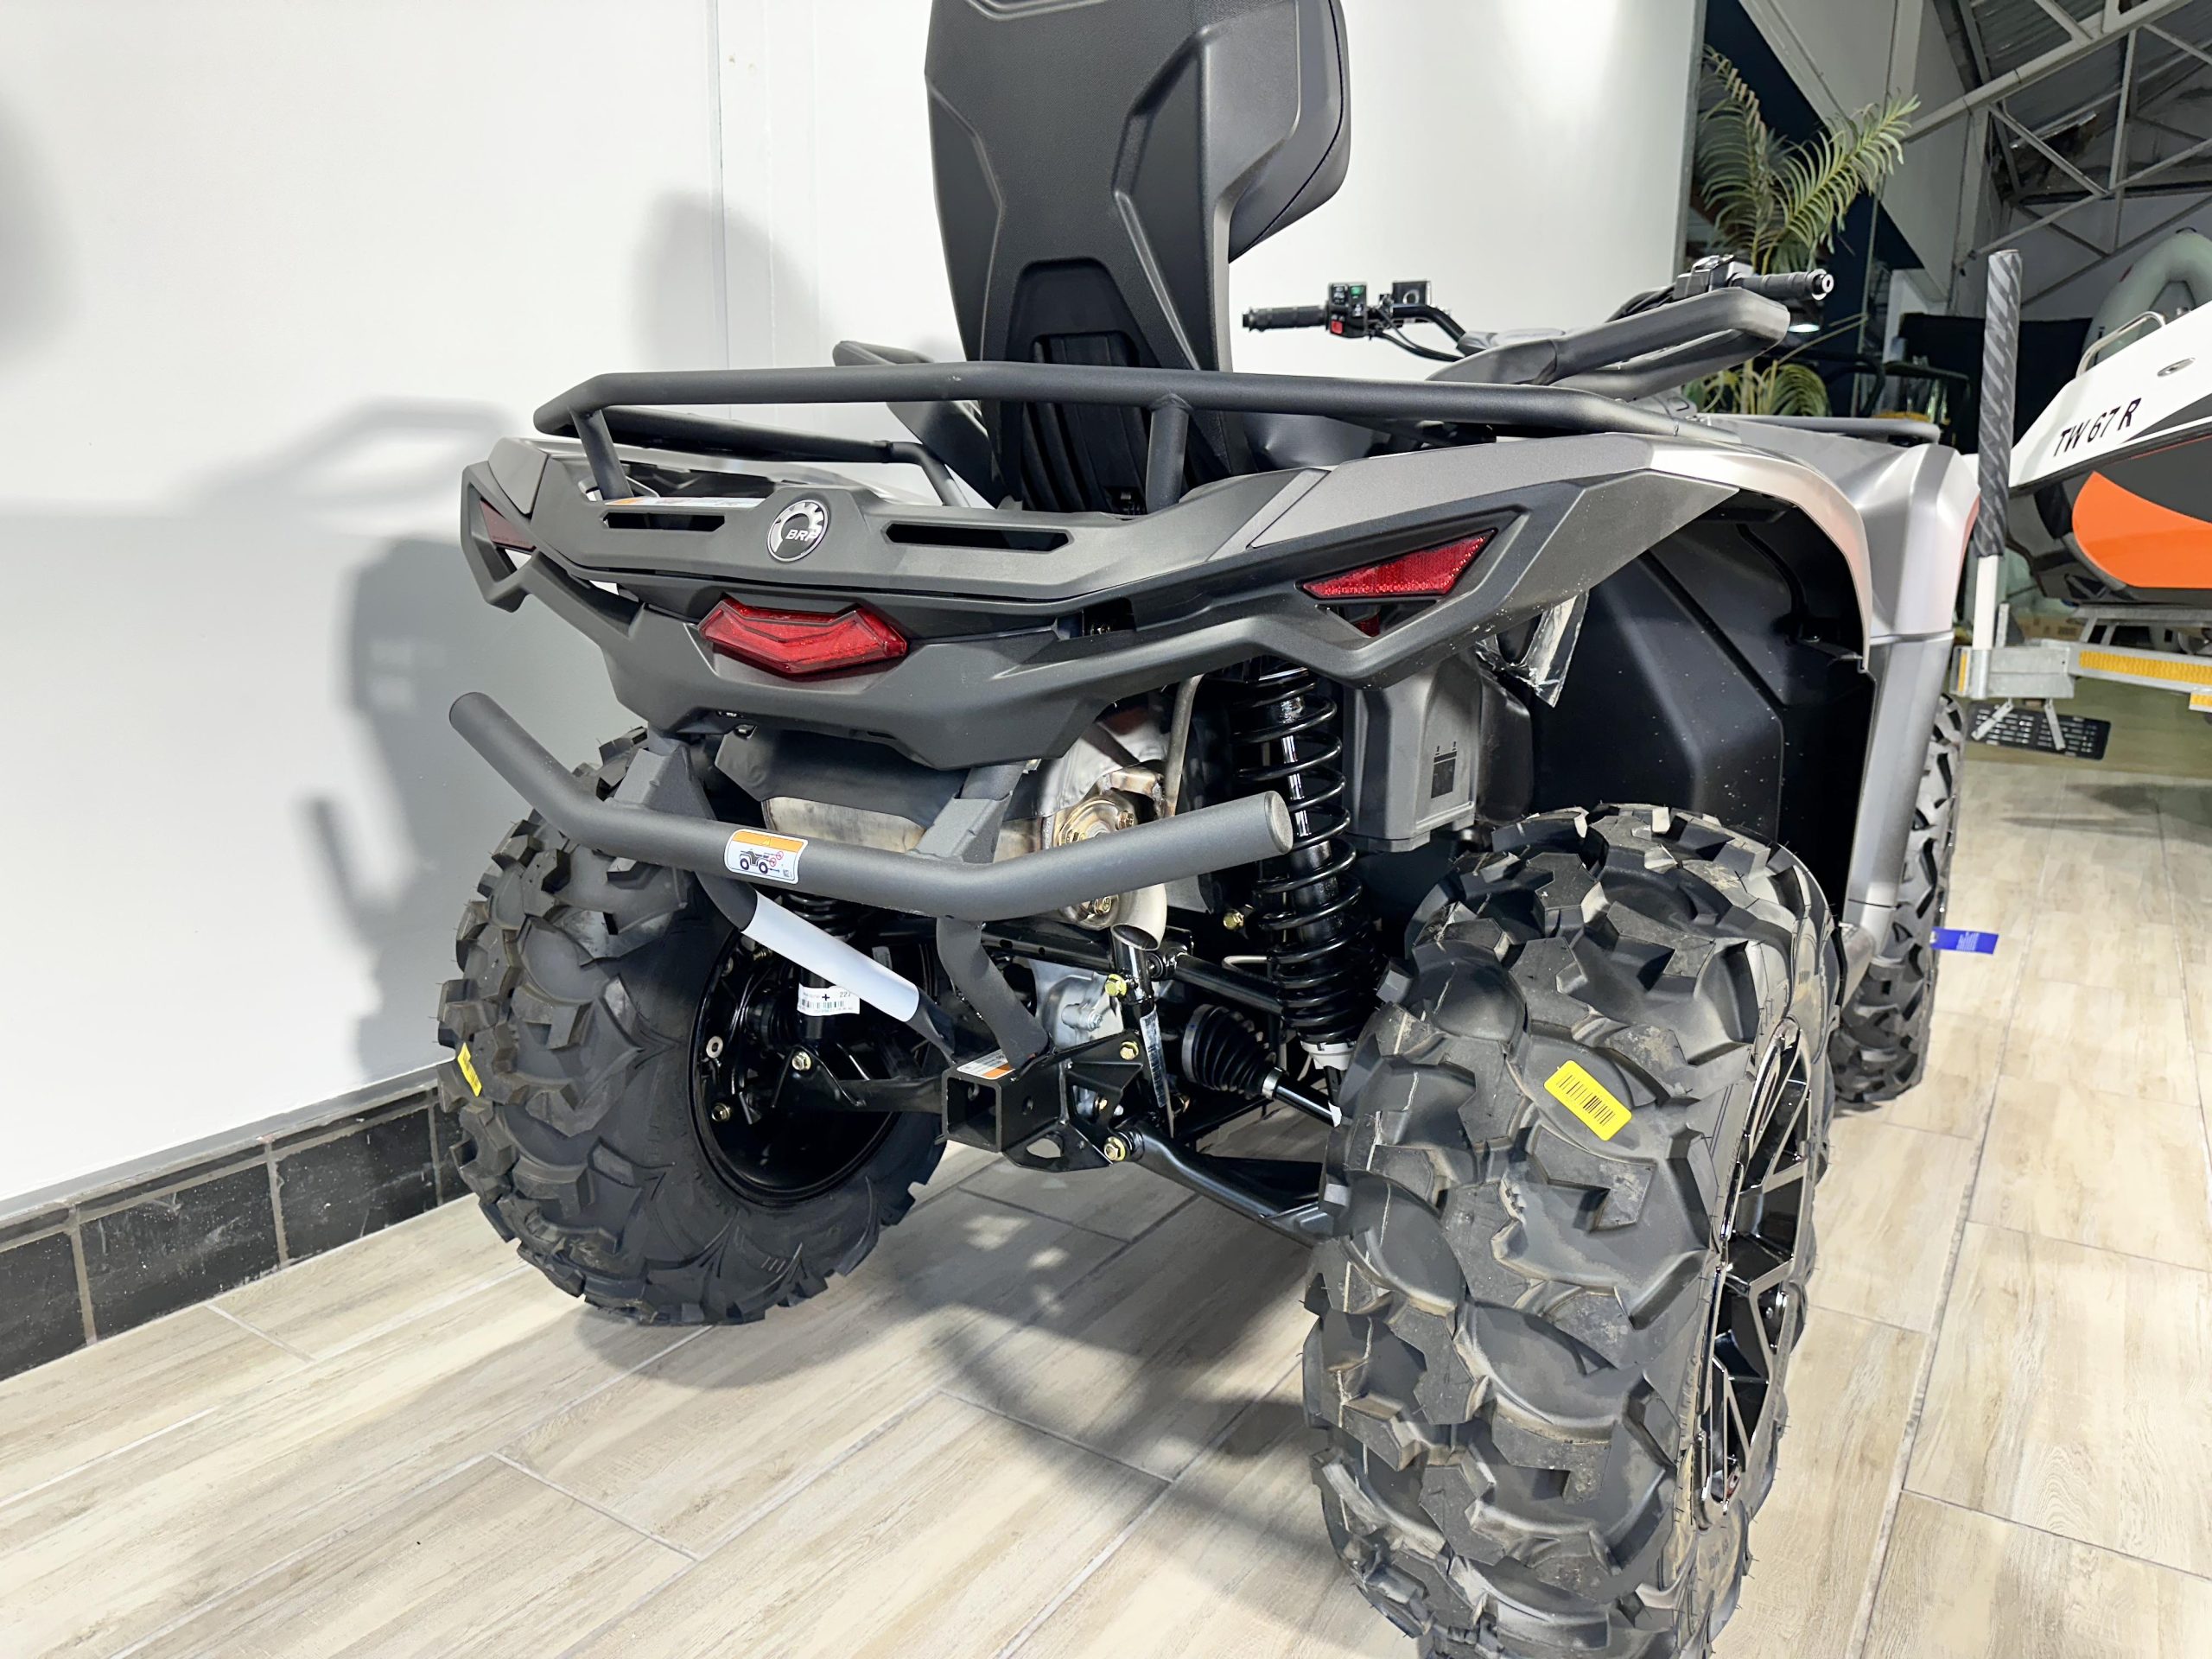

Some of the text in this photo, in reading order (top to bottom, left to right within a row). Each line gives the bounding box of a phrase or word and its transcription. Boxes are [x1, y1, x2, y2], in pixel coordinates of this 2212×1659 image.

[2054, 397, 2142, 456] TW 67 R
[785, 528, 820, 542] BRP
